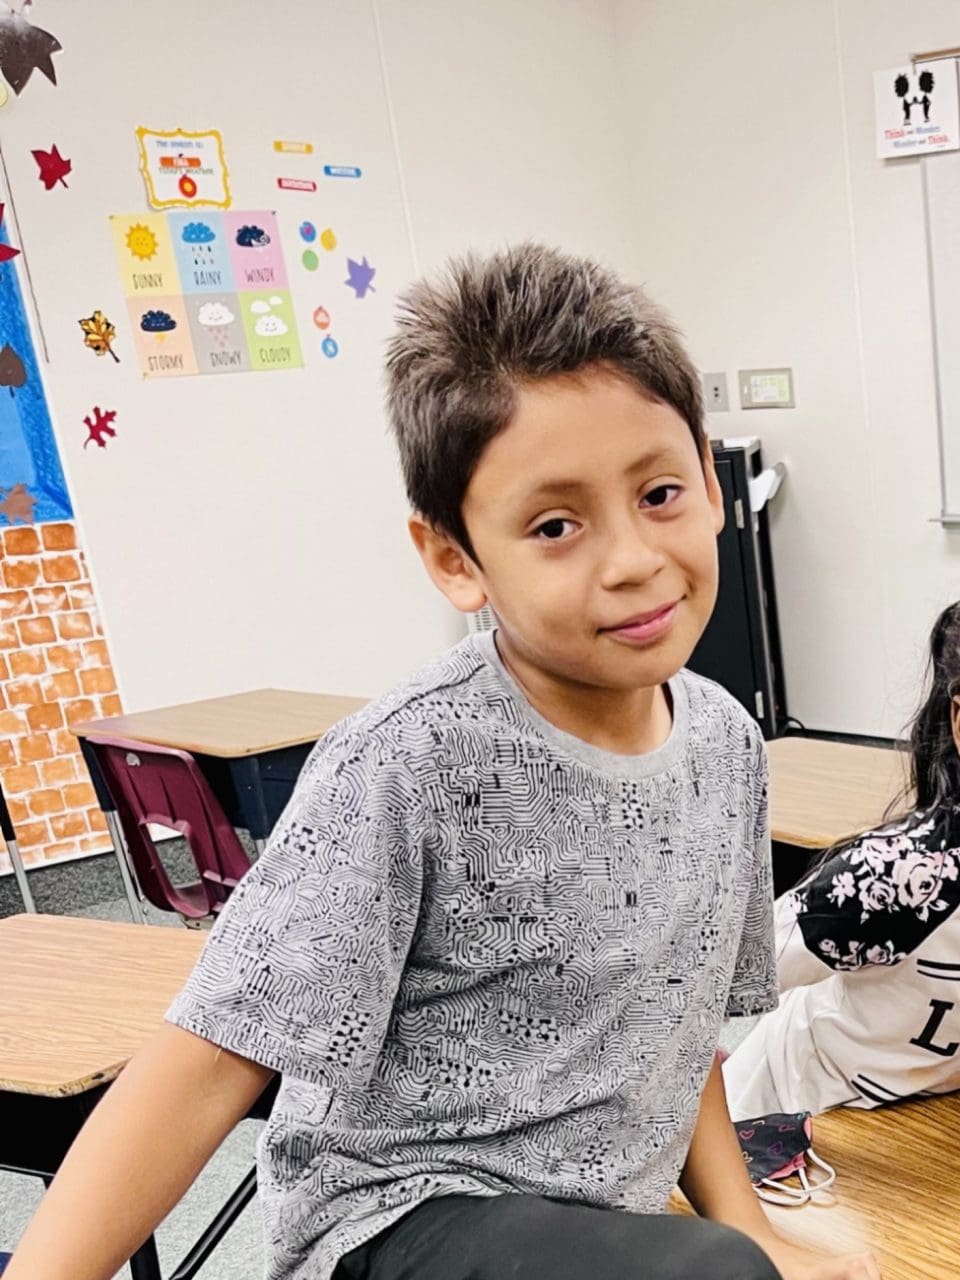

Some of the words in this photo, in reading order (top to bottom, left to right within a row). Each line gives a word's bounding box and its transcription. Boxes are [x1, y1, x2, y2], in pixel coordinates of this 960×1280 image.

[132, 273, 164, 290] SUNNY
[194, 270, 223, 286] RAINY
[244, 267, 275, 283] WINDY
[148, 354, 184, 371] STORMY
[210, 351, 242, 367] SNOWY
[259, 347, 292, 363] CLOUDY
